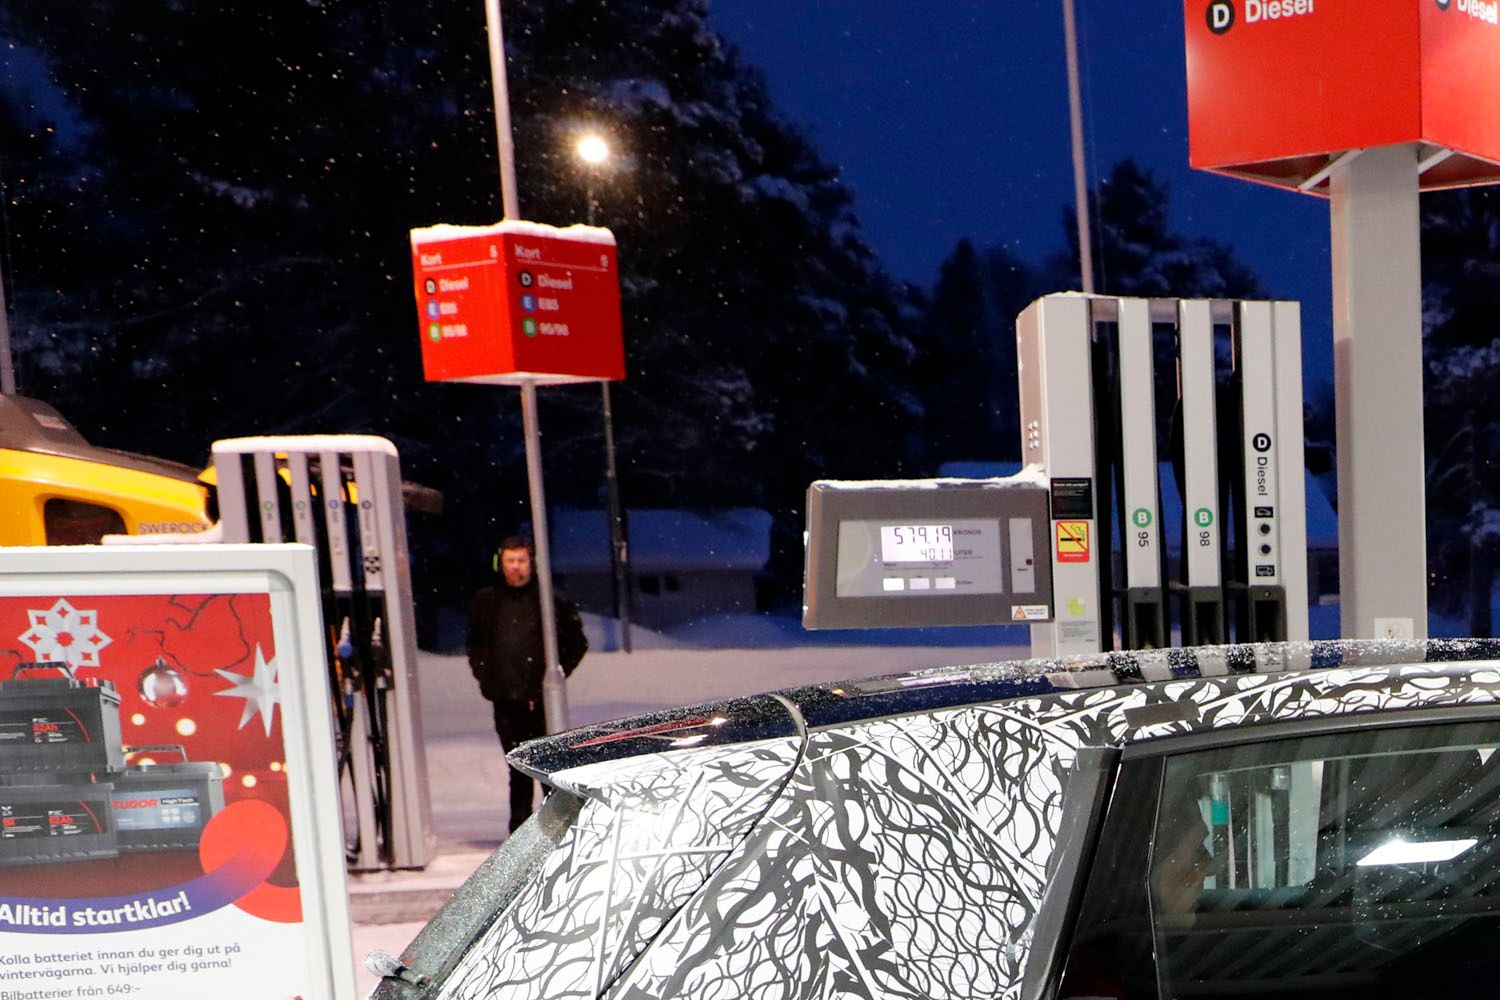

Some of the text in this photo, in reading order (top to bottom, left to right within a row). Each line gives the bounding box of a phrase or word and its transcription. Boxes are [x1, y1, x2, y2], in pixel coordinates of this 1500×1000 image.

[1212, 0, 1314, 28] D Diesel
[1457, 0, 1498, 25] Diesel
[514, 244, 541, 259] Kort
[439, 276, 469, 292] Diesel
[537, 274, 573, 290] Diesel
[1257, 456, 1268, 496] Diesel
[139, 521, 208, 535] SWEROCK
[1137, 531, 1150, 547] 95
[1199, 531, 1210, 547] 98
[112, 798, 158, 809] TUDOR
[0, 891, 192, 927] Alltid startklar!
[34, 951, 93, 964] batteriet
[97, 950, 135, 961] innan
[138, 948, 155, 958] du
[158, 949, 180, 959] ger
[183, 945, 203, 958] dig
[207, 945, 221, 955] ut
[224, 942, 241, 956] på
[0, 958, 232, 980] vintervägarna. Vi hjälper dig gärna!
[77, 985, 103, 997] från
